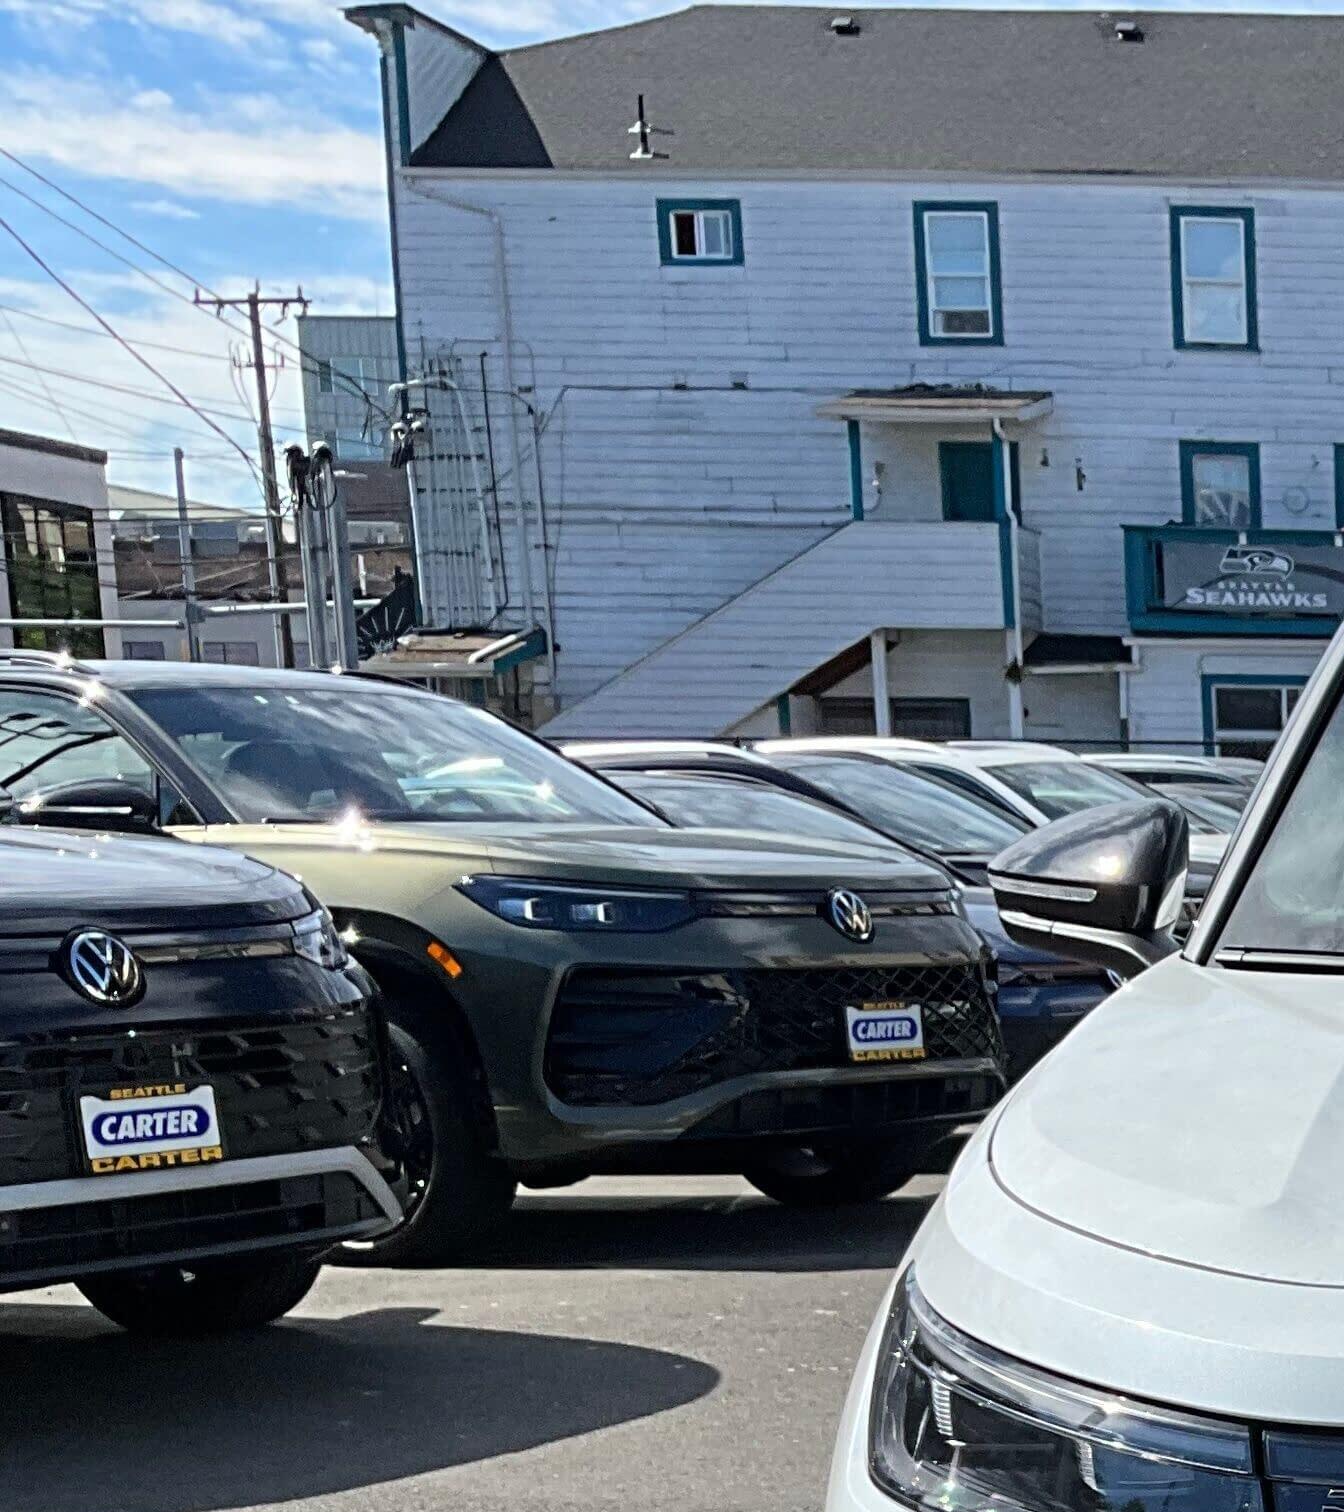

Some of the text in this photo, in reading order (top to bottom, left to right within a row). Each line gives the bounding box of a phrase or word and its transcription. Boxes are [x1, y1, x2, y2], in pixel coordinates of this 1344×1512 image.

[1186, 586, 1328, 609] SEAHAWKS
[857, 1020, 912, 1039] CARTER
[109, 1084, 186, 1100] SEATTLE
[100, 1109, 198, 1141] CARTER
[92, 1146, 223, 1173] CARTER
